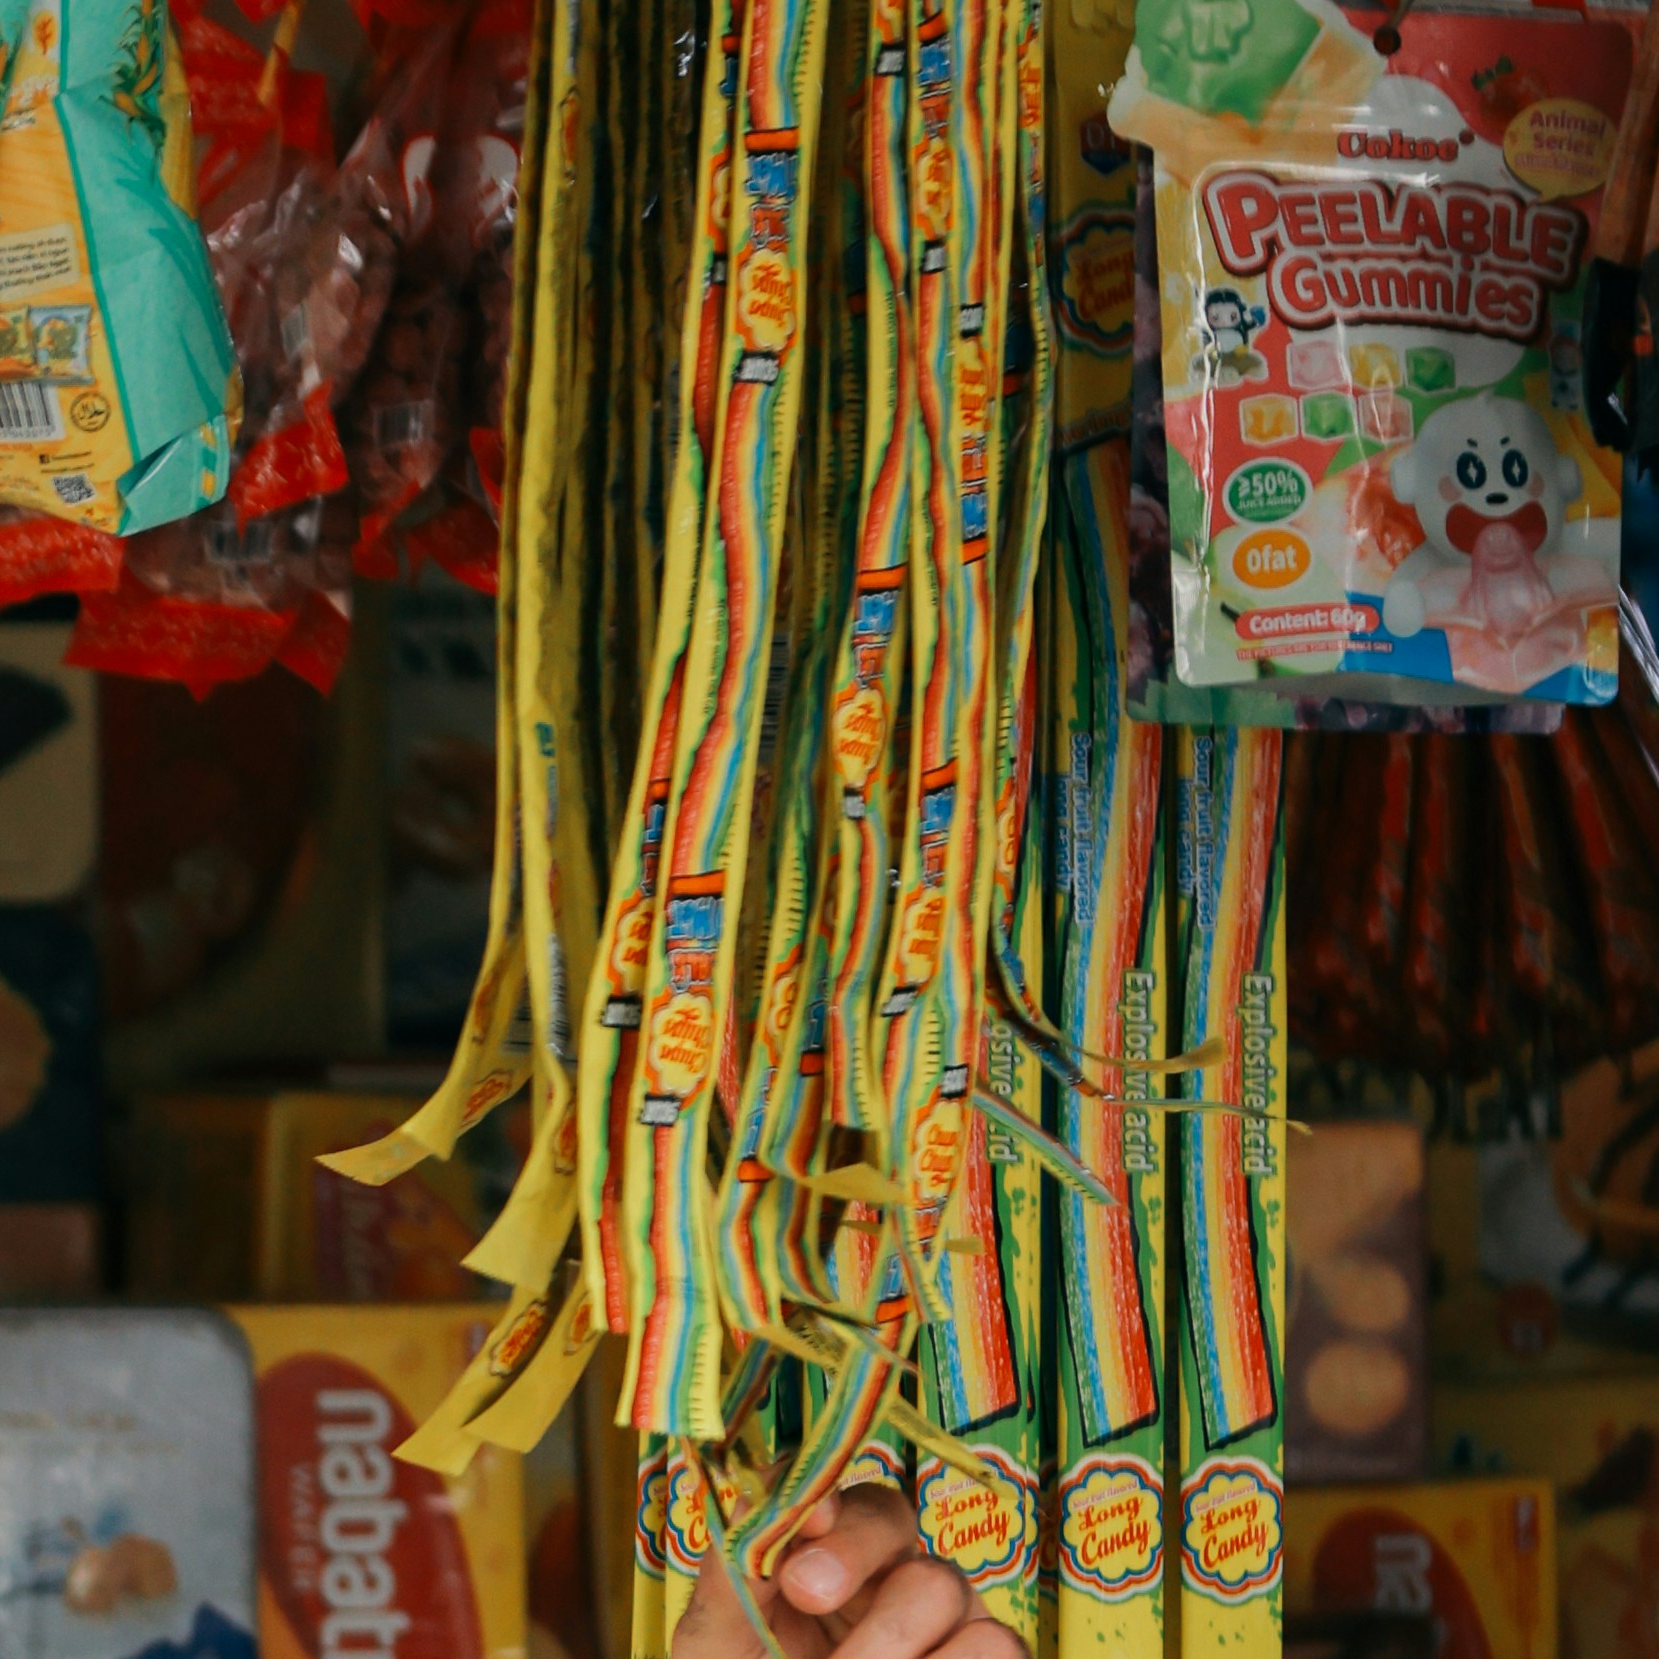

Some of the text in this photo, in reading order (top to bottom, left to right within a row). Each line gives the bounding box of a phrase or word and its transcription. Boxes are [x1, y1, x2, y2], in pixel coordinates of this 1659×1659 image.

[1210, 176, 1583, 282] PEELABLE
[1276, 252, 1538, 330] Gummies
[1246, 544, 1298, 574] 0fat
[1249, 609, 1329, 635] Content:
[1071, 733, 1094, 926] Sour fruit flavored
[1194, 736, 1216, 931] Sour fruit flavored
[1118, 969, 1156, 1173] Explosve acid
[1236, 973, 1273, 1176] Explosive acid
[935, 1489, 1000, 1524] Long
[1078, 1493, 1142, 1533] Long
[1200, 1496, 1260, 1535] Long
[938, 1511, 1011, 1557] Candy
[1080, 1516, 1152, 1566] Candy
[1203, 1521, 1270, 1569] Candy
